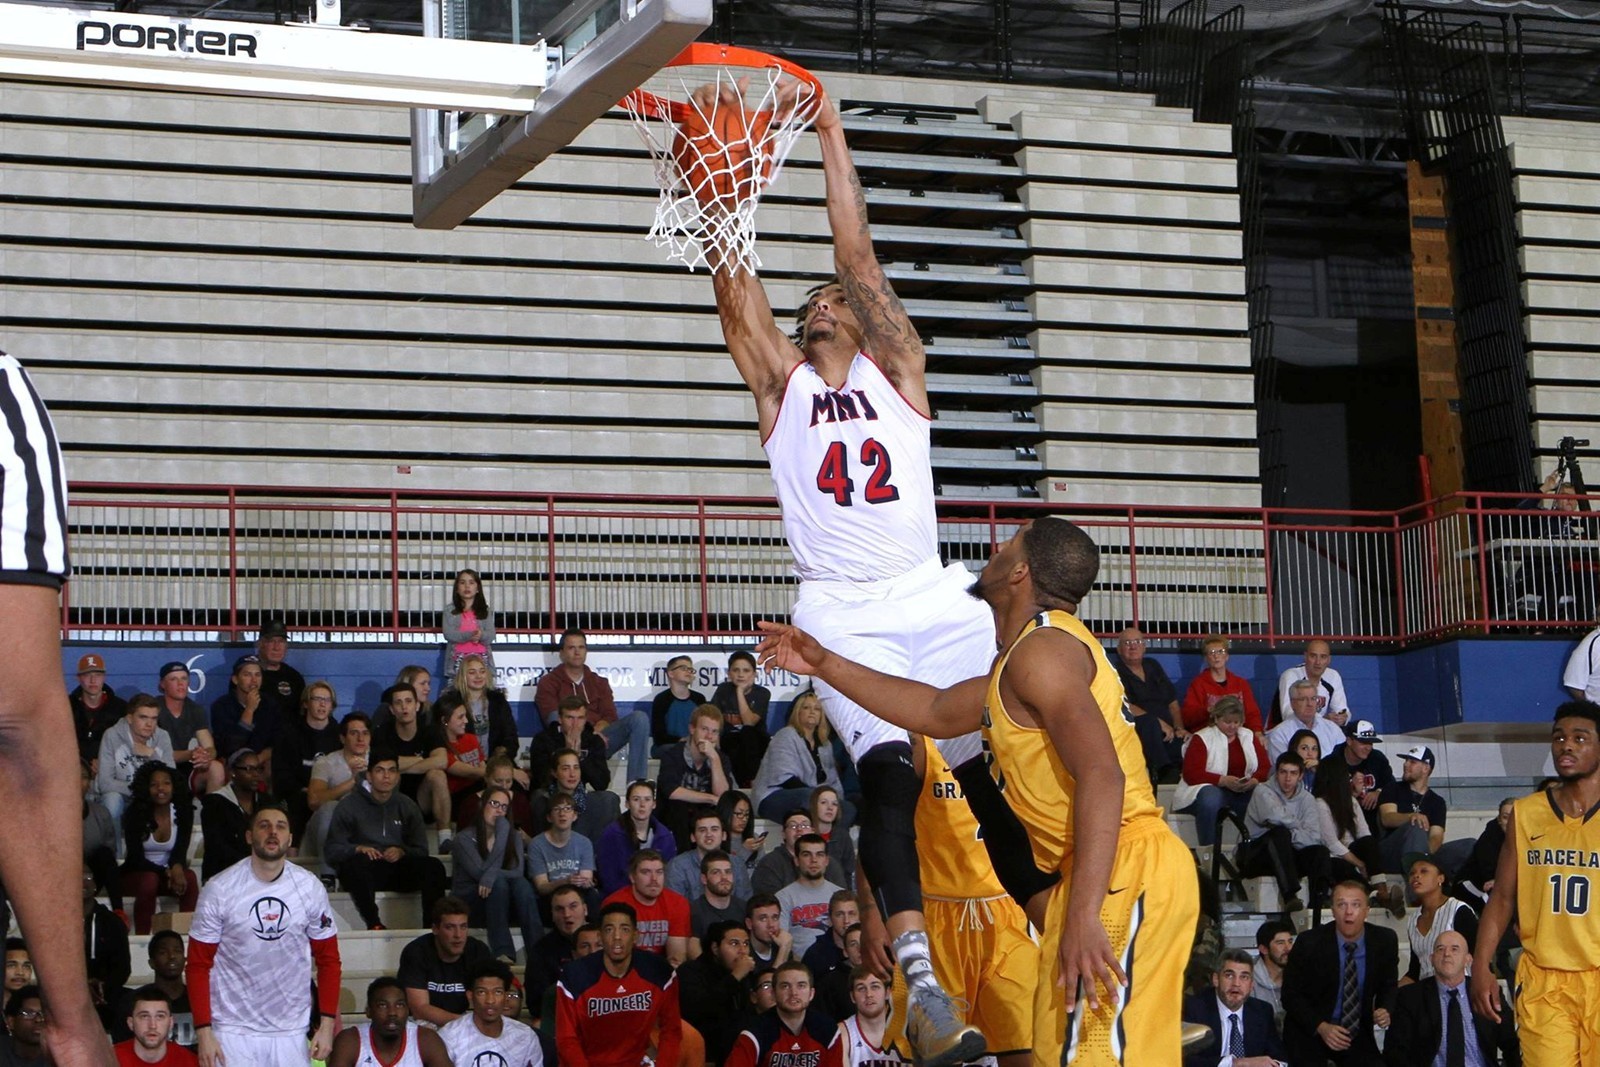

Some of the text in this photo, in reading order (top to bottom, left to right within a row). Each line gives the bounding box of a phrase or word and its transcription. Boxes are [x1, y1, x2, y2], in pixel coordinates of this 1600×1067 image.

[816, 437, 900, 507] 42
[187, 654, 207, 694] 6
[495, 666, 552, 687] ESER
[643, 666, 669, 687] MN
[698, 666, 801, 687] STENTS
[932, 781, 966, 799] GR
[1548, 873, 1590, 916] 10
[588, 990, 652, 1018] PIONEERS
